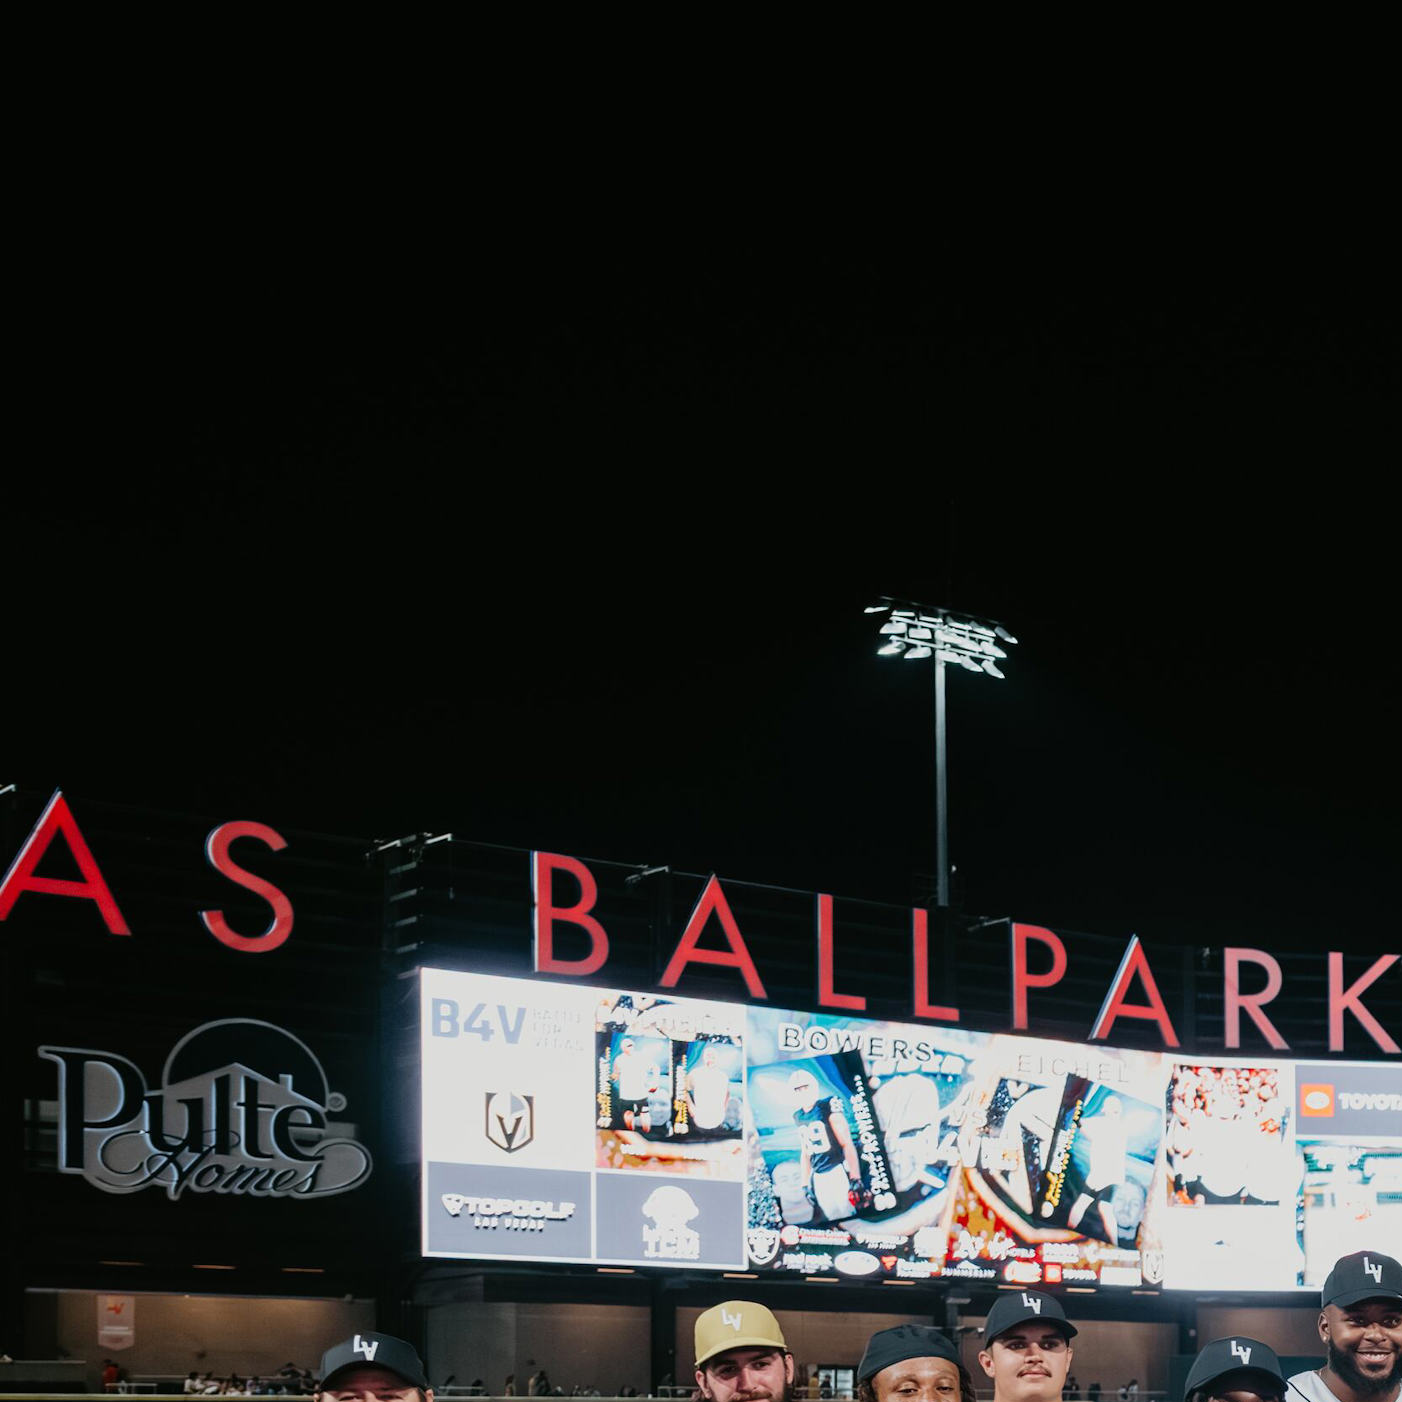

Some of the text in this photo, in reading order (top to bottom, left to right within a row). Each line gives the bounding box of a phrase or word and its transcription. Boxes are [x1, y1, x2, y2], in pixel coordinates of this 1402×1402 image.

[531, 850, 1402, 1055] BALLPARK
[431, 997, 527, 1045] B4V
[781, 1025, 935, 1063] BOWERS
[1017, 1053, 1130, 1083] EICHEL
[39, 1046, 326, 1171] Pulte
[99, 1129, 370, 1199] Homes
[463, 1196, 577, 1221] TOPGOLF
[1363, 1257, 1383, 1284] LV
[1021, 1292, 1042, 1315] LV
[722, 1308, 743, 1332] LV
[354, 1334, 379, 1361] LV
[1231, 1340, 1252, 1365] LV
